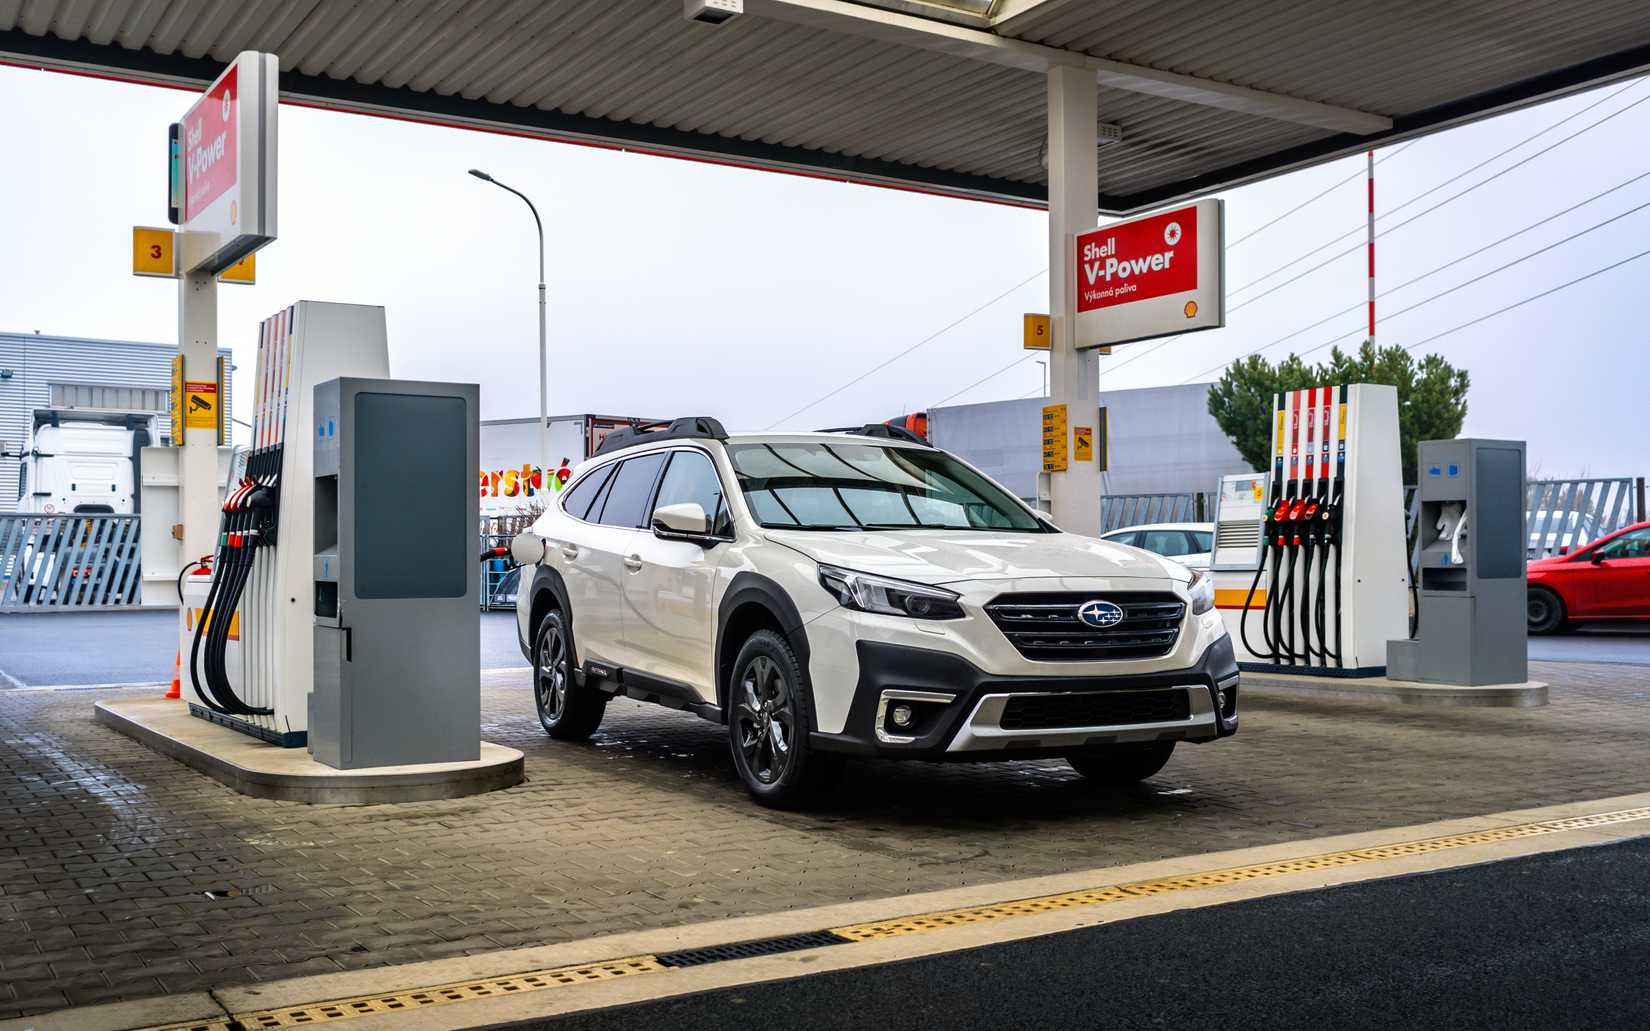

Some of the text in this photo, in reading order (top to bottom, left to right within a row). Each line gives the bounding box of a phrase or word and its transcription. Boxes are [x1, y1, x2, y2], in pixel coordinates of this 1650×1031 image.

[188, 130, 228, 186] V-Power
[150, 244, 162, 259] 3
[1083, 237, 1116, 261] Shell
[1084, 250, 1175, 286] V-Power
[1084, 283, 1137, 304] Výkonná paliva
[1036, 325, 1044, 336] 5
